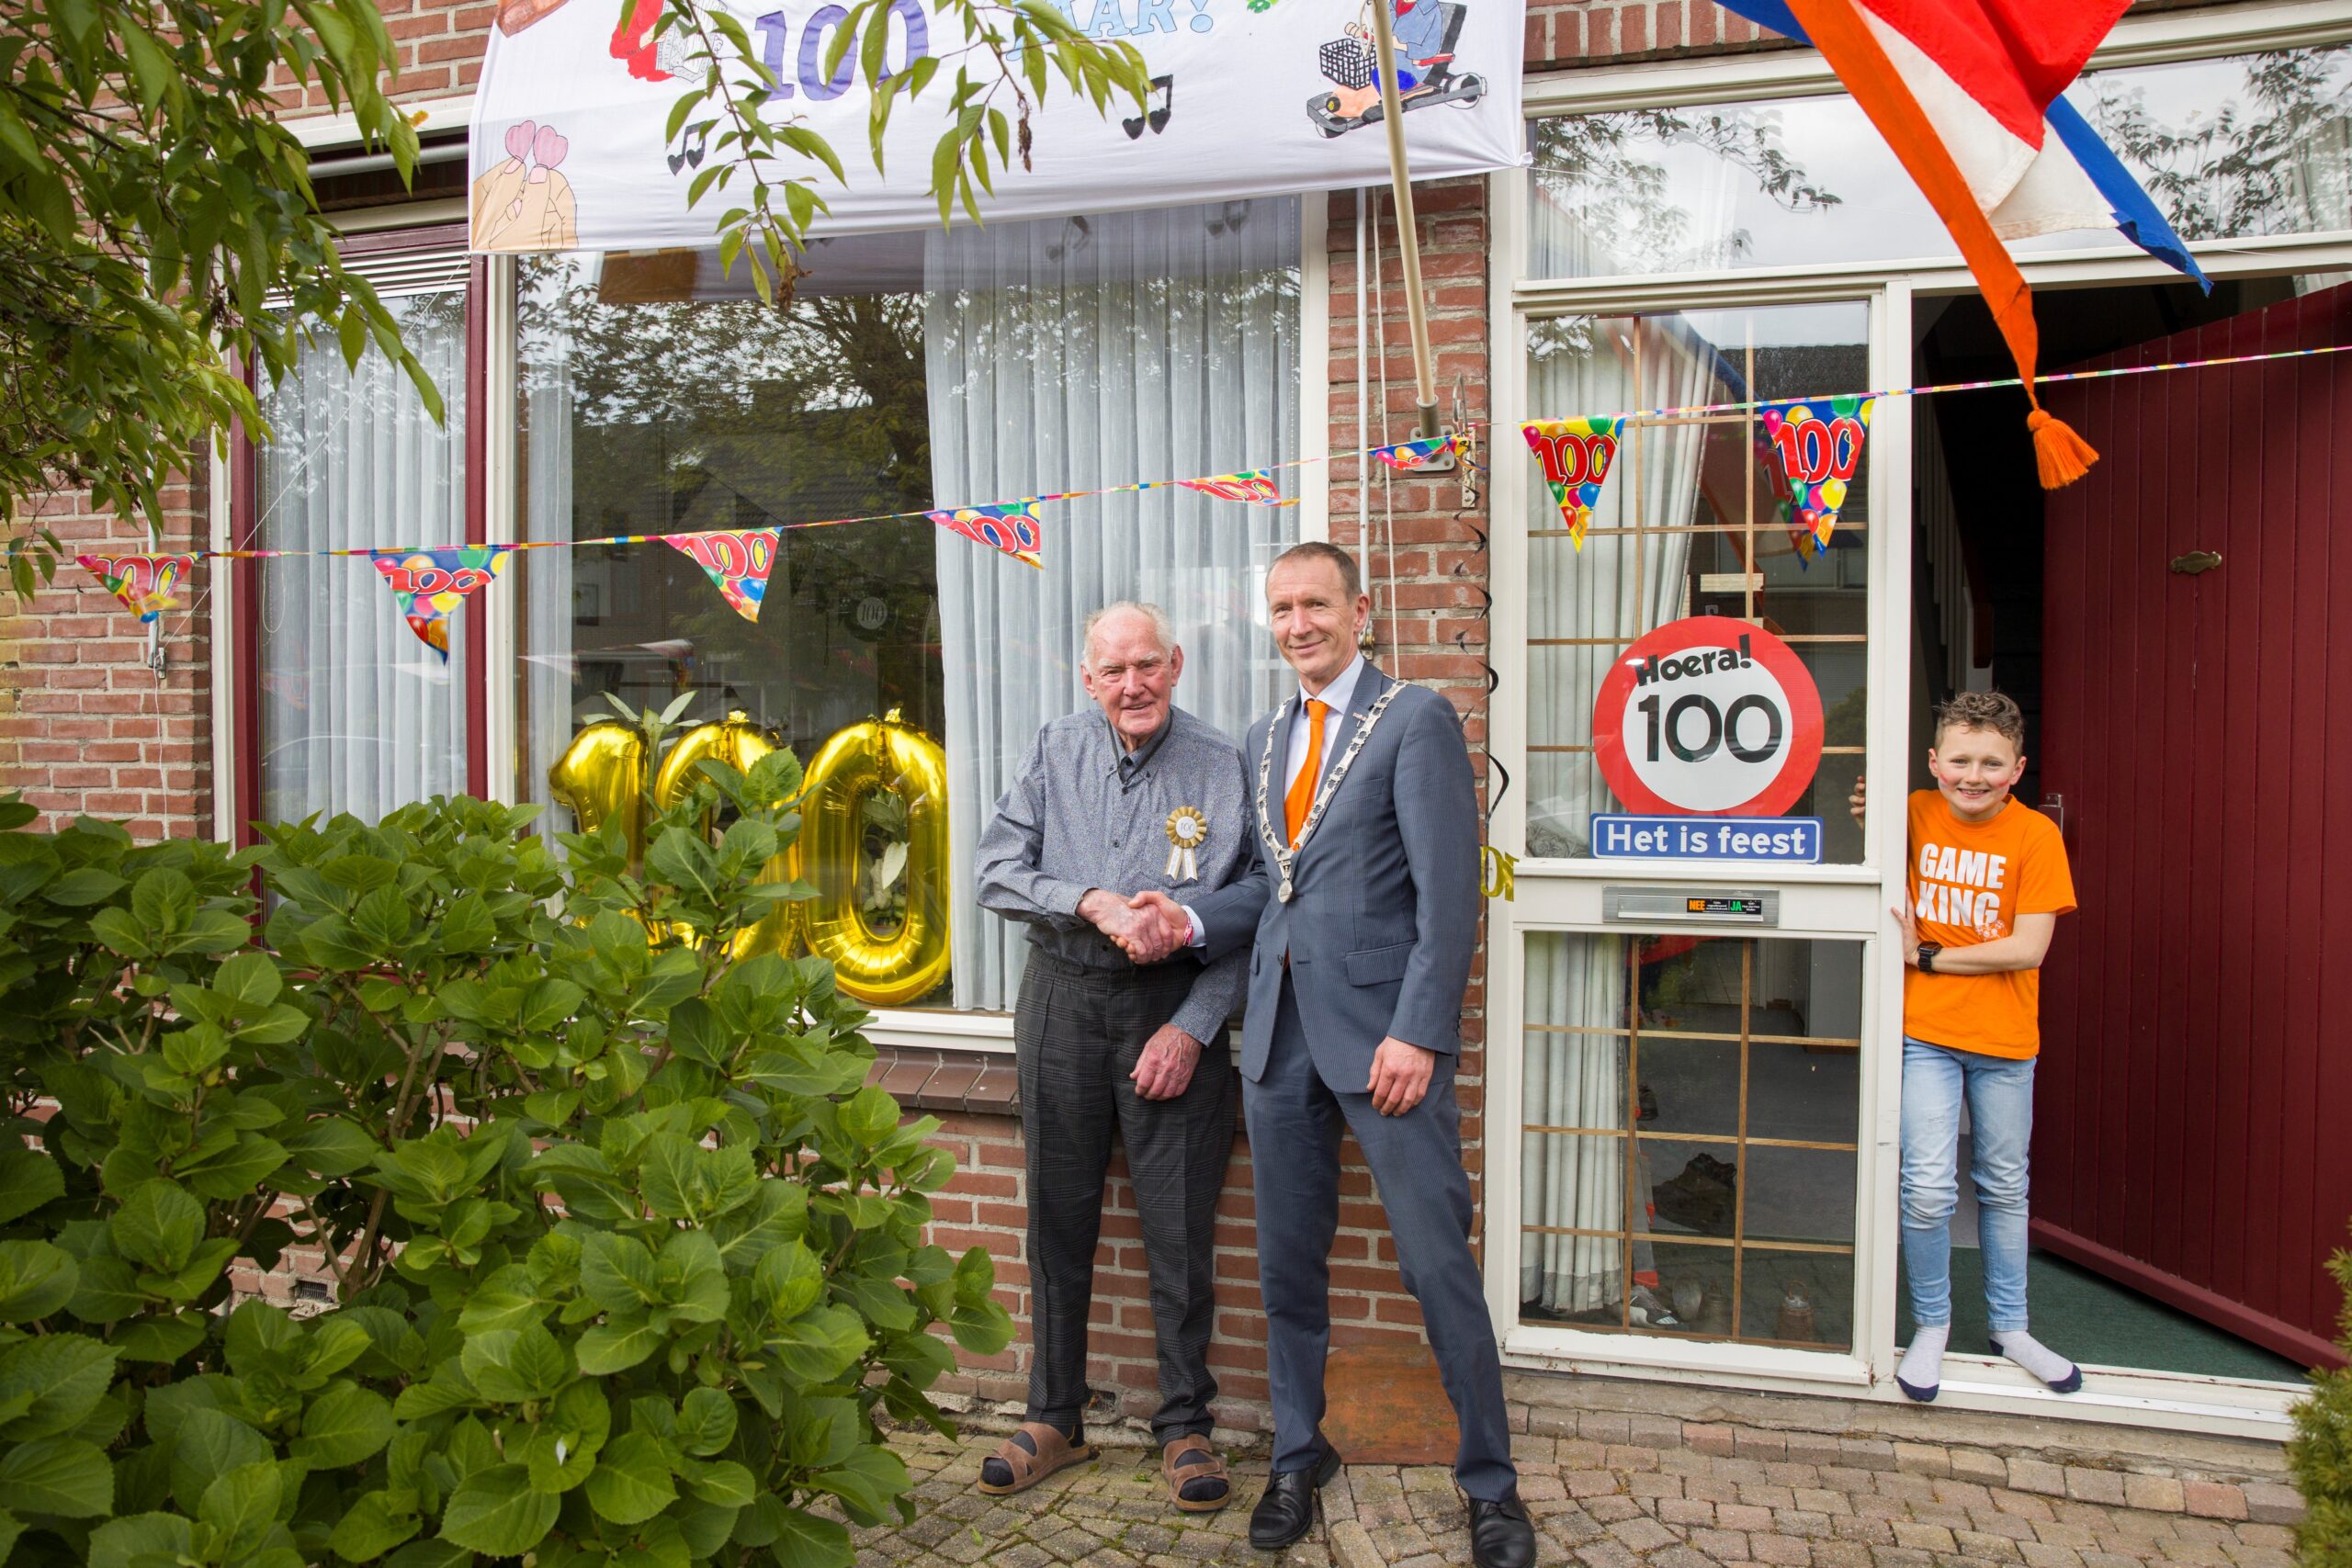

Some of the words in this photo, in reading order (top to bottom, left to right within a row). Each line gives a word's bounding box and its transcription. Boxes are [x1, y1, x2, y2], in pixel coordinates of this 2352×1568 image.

[754, 0, 929, 102] 100
[1005, 0, 1214, 61] AR!
[1533, 433, 1618, 487] 100
[1770, 418, 1865, 484] 100
[682, 531, 780, 581] 100
[381, 567, 493, 595] 100
[1634, 633, 1752, 687] Hoera!
[1637, 694, 1783, 764] 100
[1608, 823, 1668, 853] Het
[1679, 826, 1709, 853] is
[1717, 826, 1806, 855] feest
[1918, 842, 2007, 890] GAME
[1689, 899, 1705, 910] NEE
[1731, 900, 1742, 911] JA
[1915, 880, 2001, 928] KING
